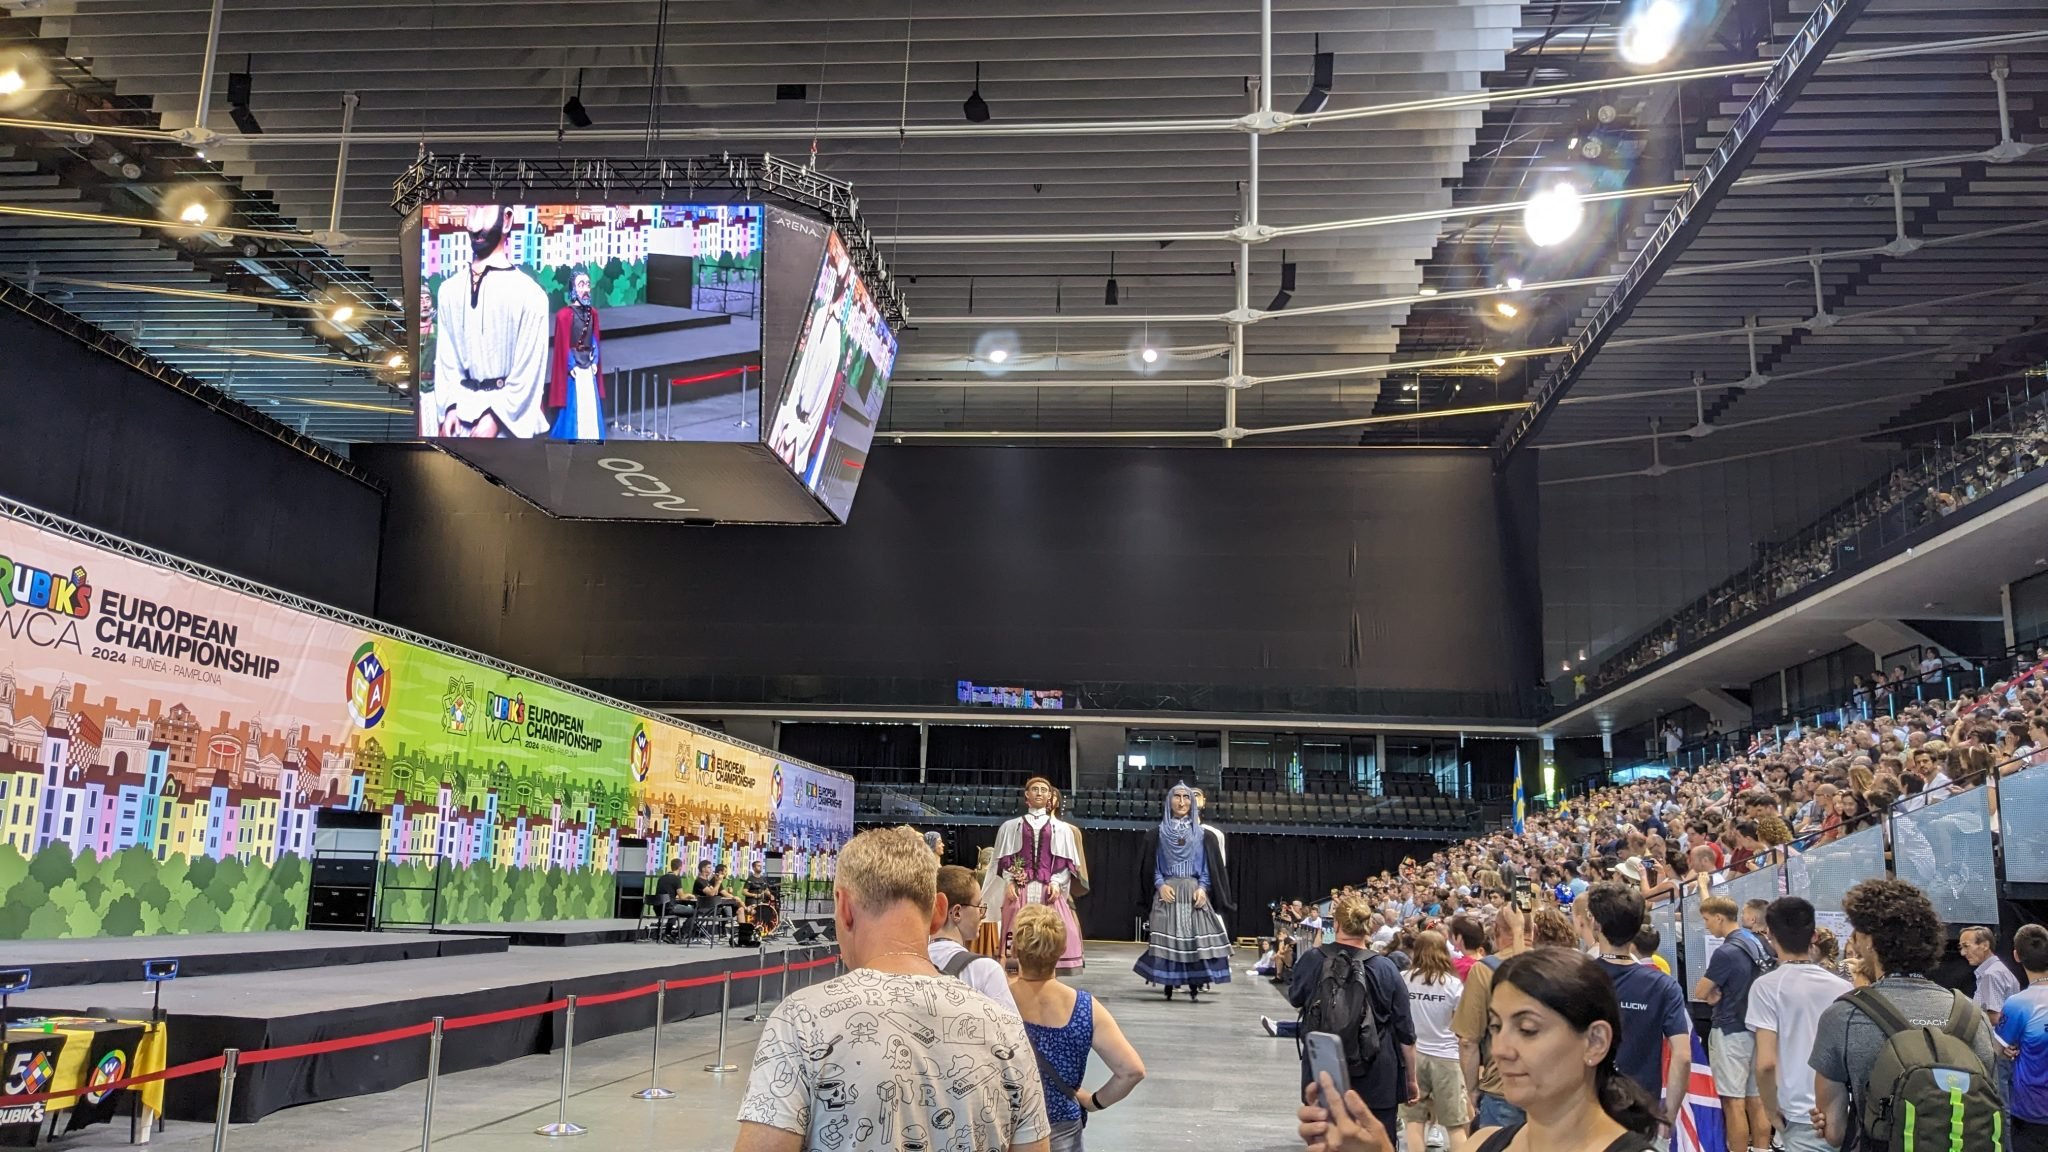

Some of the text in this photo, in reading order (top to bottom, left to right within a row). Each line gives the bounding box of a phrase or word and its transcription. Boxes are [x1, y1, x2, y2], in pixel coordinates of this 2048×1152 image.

[771, 218, 822, 239] ARENA
[100, 589, 238, 647] EUROPEAN
[96, 617, 280, 680] CHAMPIONSHIP
[92, 647, 127, 664] 2024
[132, 656, 167, 673] IRUÑEA
[173, 665, 222, 685] PAMPLONA
[485, 717, 522, 747] WCA
[528, 704, 584, 734] EUROPEAN
[525, 740, 539, 750] 2024
[526, 722, 602, 753] CHAMPIONSHIP
[715, 769, 756, 789] CHAMPIONSHIP
[716, 757, 746, 776] EUROPEAN
[820, 994, 862, 1018] SMASH
[1409, 992, 1446, 1002] STAFF
